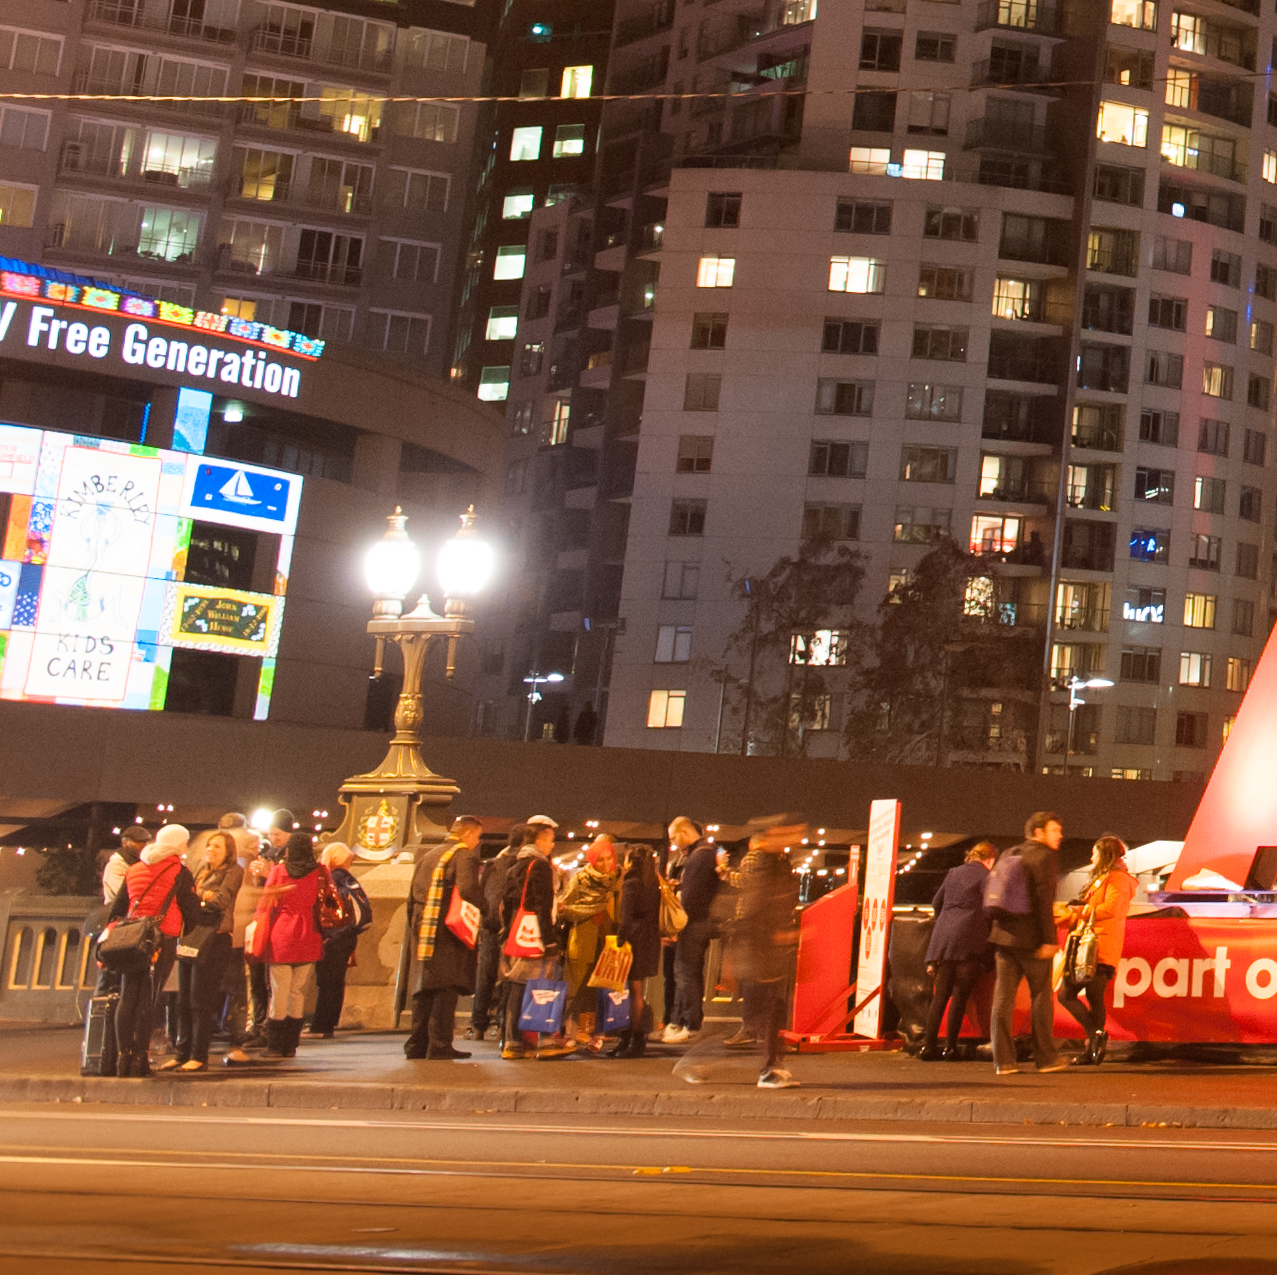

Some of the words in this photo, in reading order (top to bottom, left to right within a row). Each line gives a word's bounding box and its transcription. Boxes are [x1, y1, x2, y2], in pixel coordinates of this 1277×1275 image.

[27, 305, 111, 358] Free
[122, 323, 301, 398] Generation
[56, 632, 115, 655] KIDS
[46, 657, 112, 681] CARE
[1112, 946, 1231, 1009] part
